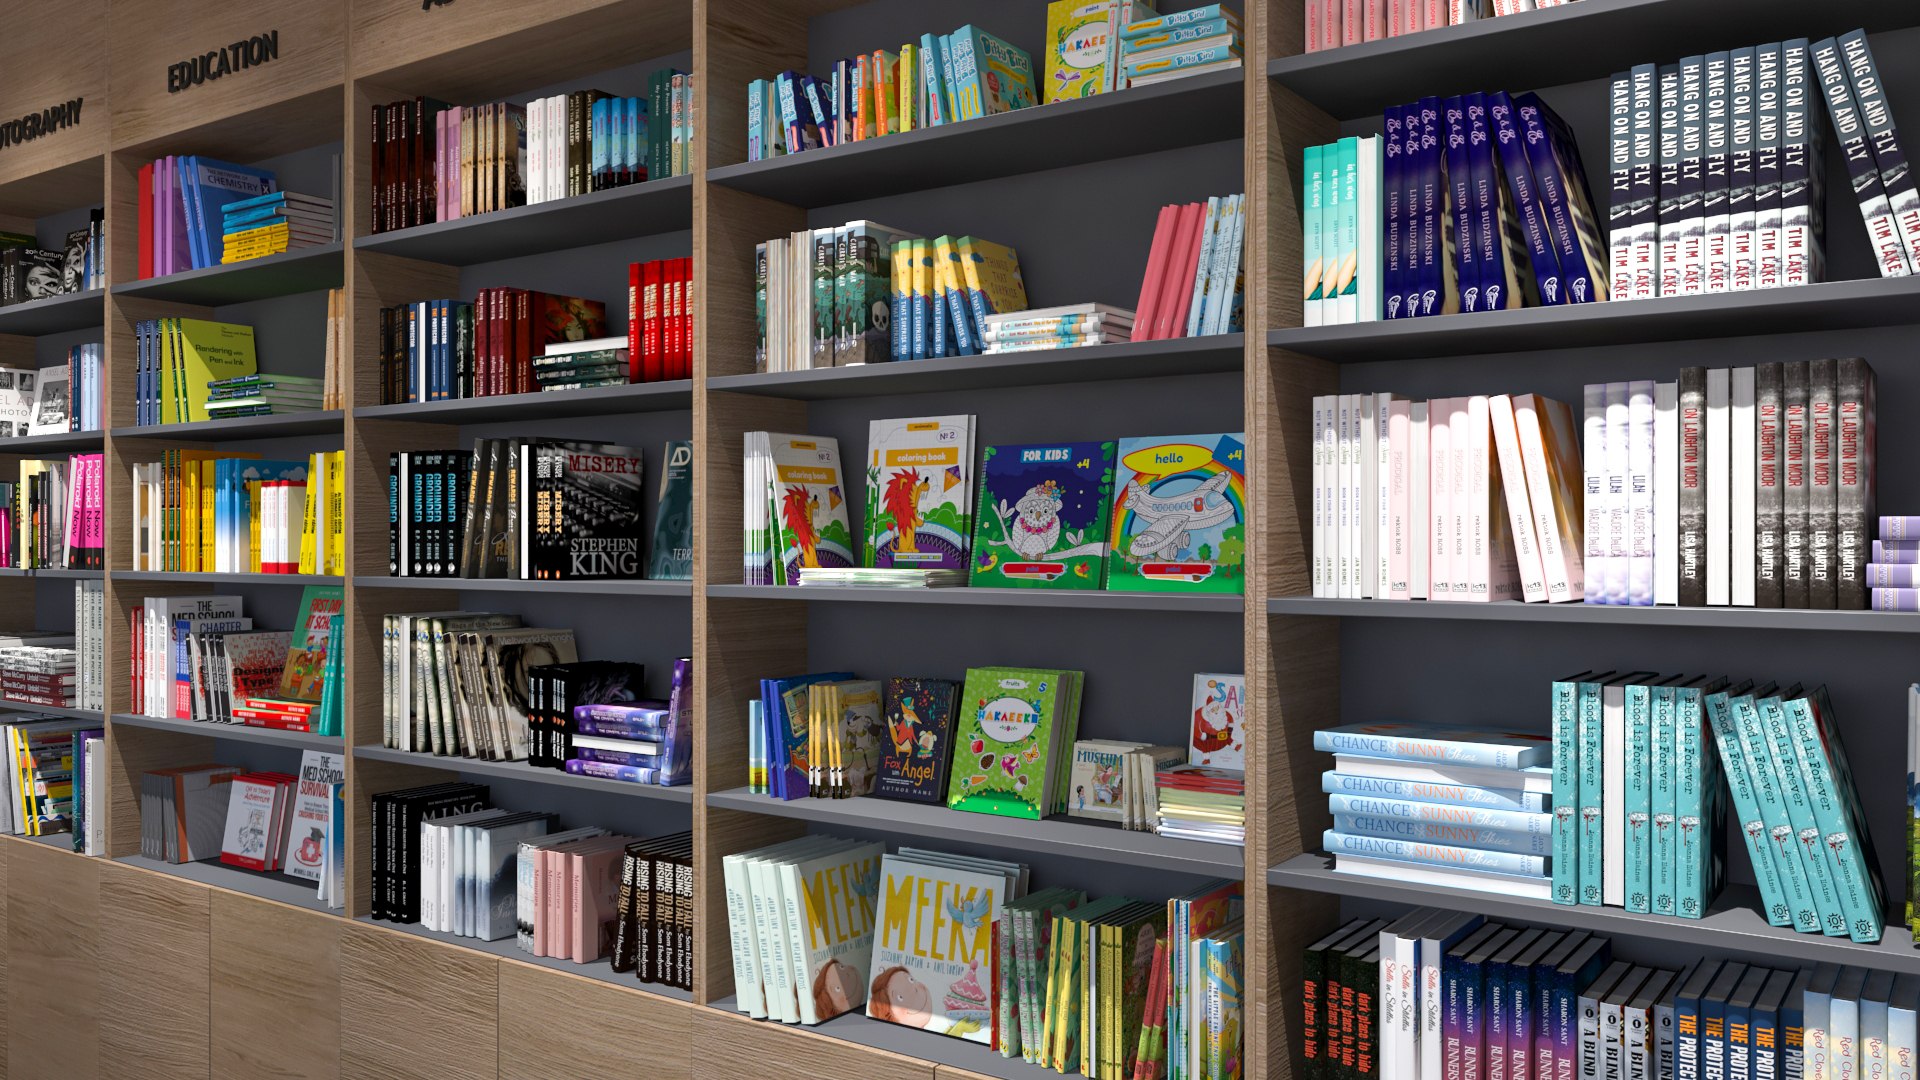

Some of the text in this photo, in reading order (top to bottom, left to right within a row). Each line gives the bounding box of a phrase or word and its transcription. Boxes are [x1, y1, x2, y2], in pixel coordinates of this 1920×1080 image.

[1168, 9, 1206, 26] Ditty Bird
[980, 34, 1006, 62] Ditty
[1058, 34, 1106, 55] НАКЛЕЕ
[168, 30, 278, 93] EDUCATION
[1786, 47, 1803, 166] HANG ON AND FLY
[1844, 38, 1898, 155] HANG ON AND FLY
[208, 175, 258, 192] CHEMISTRY
[1425, 184, 1433, 265] LINDA BUDZINSKI
[1515, 175, 1545, 255] LINDA BUDZINSKI
[39, 250, 63, 260] Century
[1788, 227, 1802, 282] TIM LAKE
[1873, 217, 1903, 273] TIM LAKE
[673, 281, 681, 317] NAMELESS
[950, 291, 960, 310] THAT
[954, 310, 964, 339] SURPRISE
[195, 344, 232, 356] Rendering
[209, 356, 223, 364] Pen
[233, 358, 244, 366] Ink
[1842, 402, 1857, 486] ON LAUGHTON MOOR
[568, 454, 640, 474] MISERY
[897, 452, 946, 463] coloring book
[1023, 449, 1068, 462] FOR KIDS
[1076, 459, 1090, 469] +4
[1155, 453, 1183, 464] hello
[1227, 450, 1242, 461] +4
[74, 460, 85, 508] Polaroid
[787, 470, 827, 480] coloring book
[1632, 474, 1645, 493] LILAH
[389, 475, 397, 522] GROUNDED
[414, 473, 422, 522] GROUNDED
[570, 538, 638, 552] STEPHEN
[570, 551, 638, 576] KING
[1842, 531, 1855, 581] LISA HARTLEY
[197, 600, 213, 612] THE
[310, 598, 329, 612] FIRST
[200, 621, 242, 633] CHARTER
[234, 664, 285, 676] Designi
[1038, 683, 1047, 693] 5
[1332, 735, 1478, 762] CHANCE SUNNY Skies
[1560, 691, 1570, 786] Blood is Forever
[320, 756, 331, 768] THE
[883, 755, 900, 771] Fox
[1077, 750, 1123, 767] MUSEUM
[1793, 708, 1831, 811] Blood is Forever
[302, 765, 318, 781] MED
[882, 786, 932, 796] AUTHOR NAME
[1350, 799, 1507, 828] CHANCE SUNNY Skies
[1840, 858, 1851, 883] Joanna
[640, 860, 649, 921] RISING TO FALL
[683, 866, 692, 928] RISING TO FALL
[882, 872, 993, 967] MEEKA
[904, 955, 923, 970] BARTON
[1401, 964, 1413, 991] Stella
[1304, 980, 1317, 1059] dark place to hide
[1466, 1014, 1474, 1034] SANT
[1705, 1017, 1723, 1037] THE
[1583, 1028, 1595, 1076] A BLIND
[1842, 1036, 1852, 1057] Red
